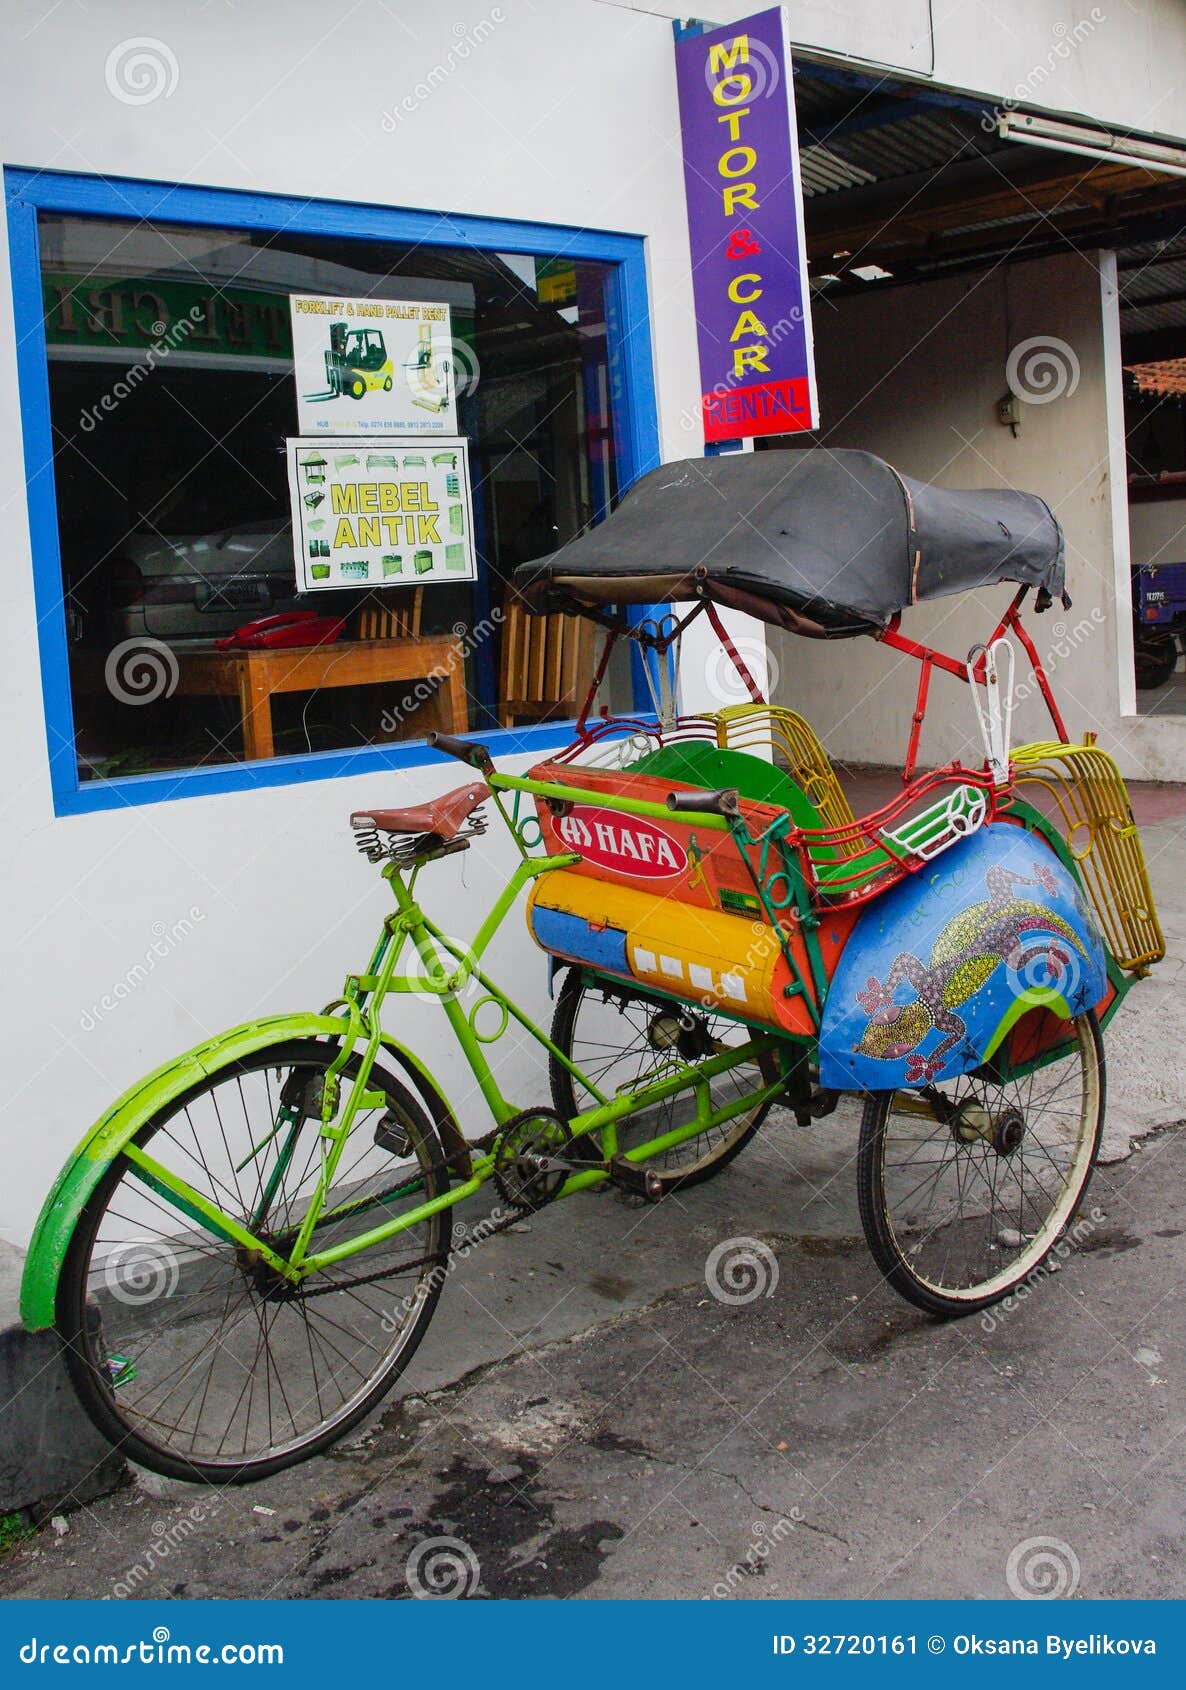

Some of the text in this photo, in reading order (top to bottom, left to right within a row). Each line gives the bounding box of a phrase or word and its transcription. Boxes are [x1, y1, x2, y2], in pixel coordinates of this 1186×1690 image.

[708, 34, 771, 378] MOTOR & CAR
[295, 300, 344, 316] FORKLIFT
[356, 304, 384, 318] HAND
[386, 305, 420, 320] PALLET
[422, 307, 447, 322] RENT
[708, 386, 804, 426] RENTAL
[331, 482, 438, 514] MEBEL
[334, 515, 442, 549] ANTIK
[594, 822, 680, 869] HAFA
